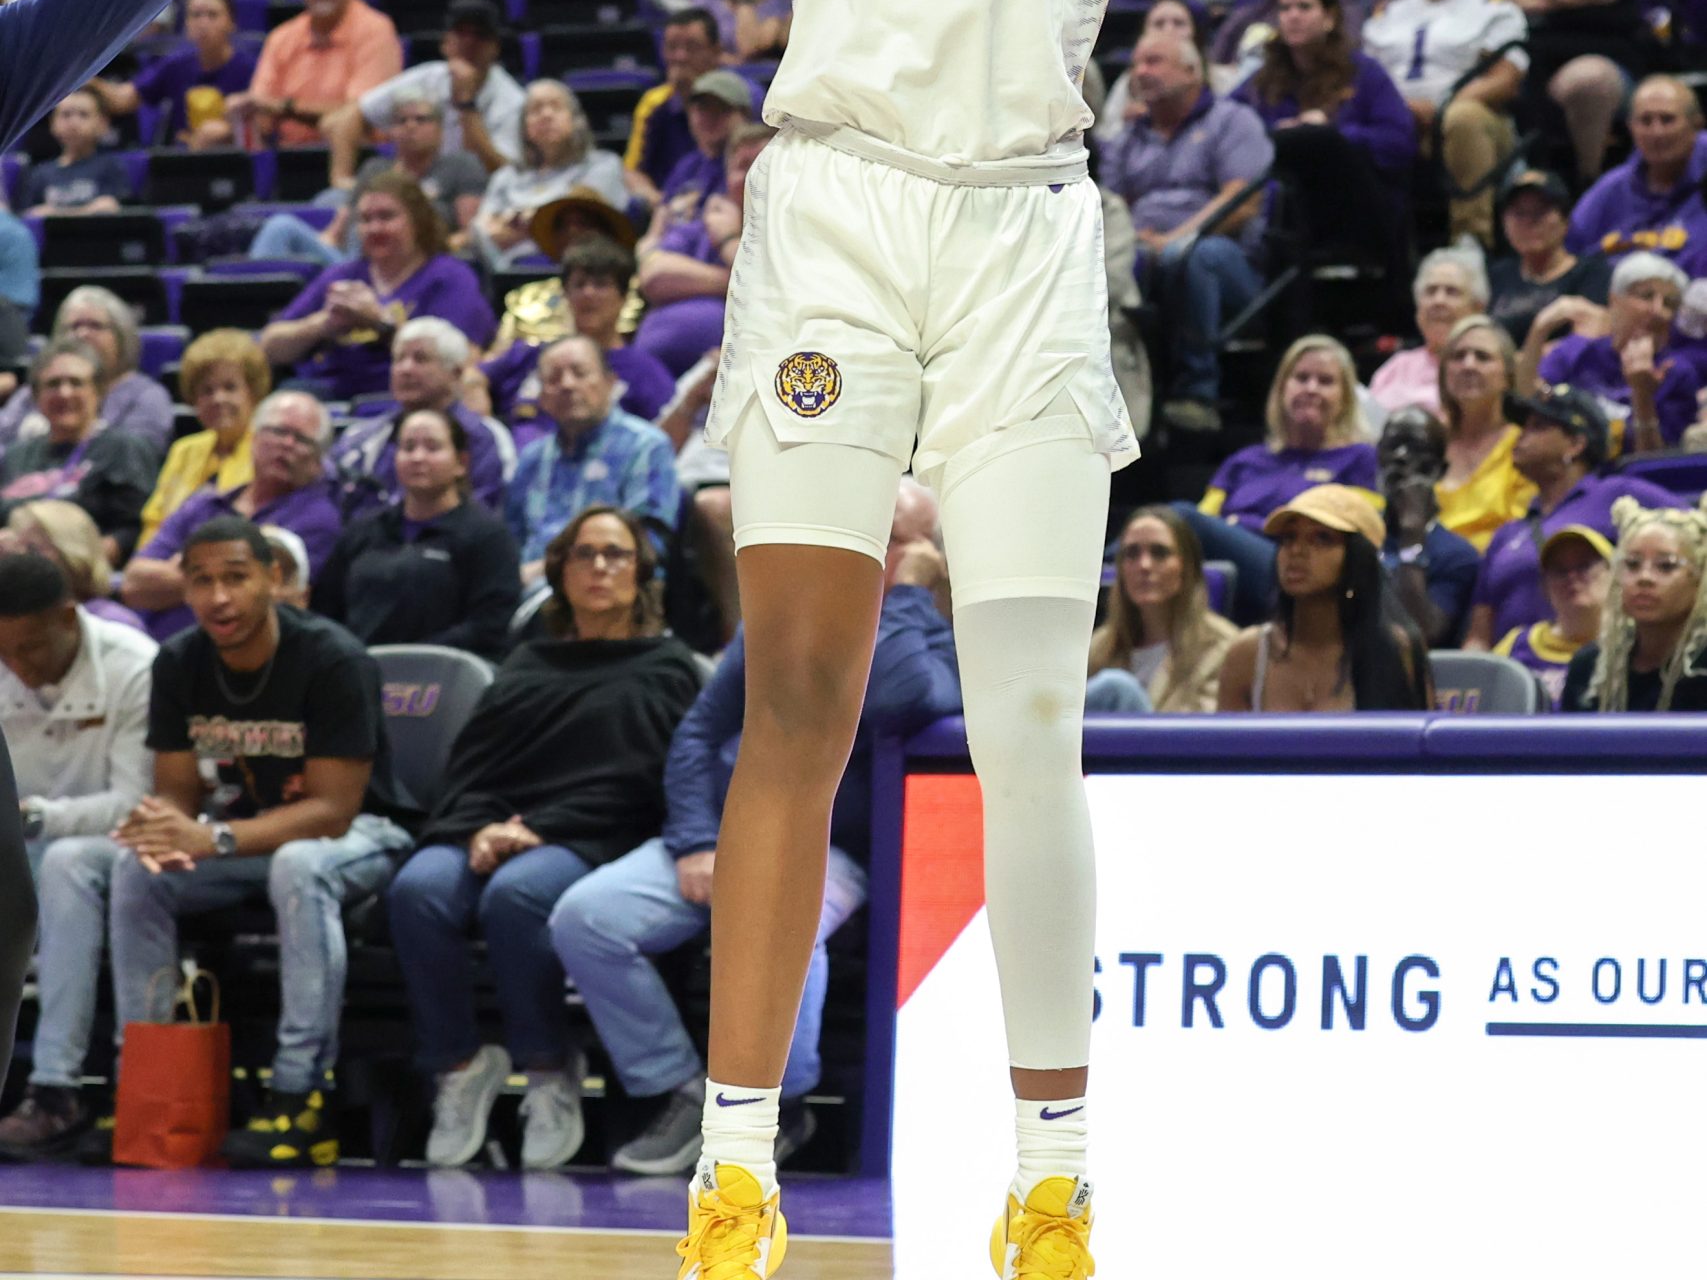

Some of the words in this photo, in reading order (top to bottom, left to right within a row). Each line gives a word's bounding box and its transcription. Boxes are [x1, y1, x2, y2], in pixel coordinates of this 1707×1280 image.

[382, 682, 442, 717] SU
[1093, 951, 1443, 1033] TRONG
[1488, 956, 1560, 1005] AS
[1591, 956, 1707, 1006] OUR
